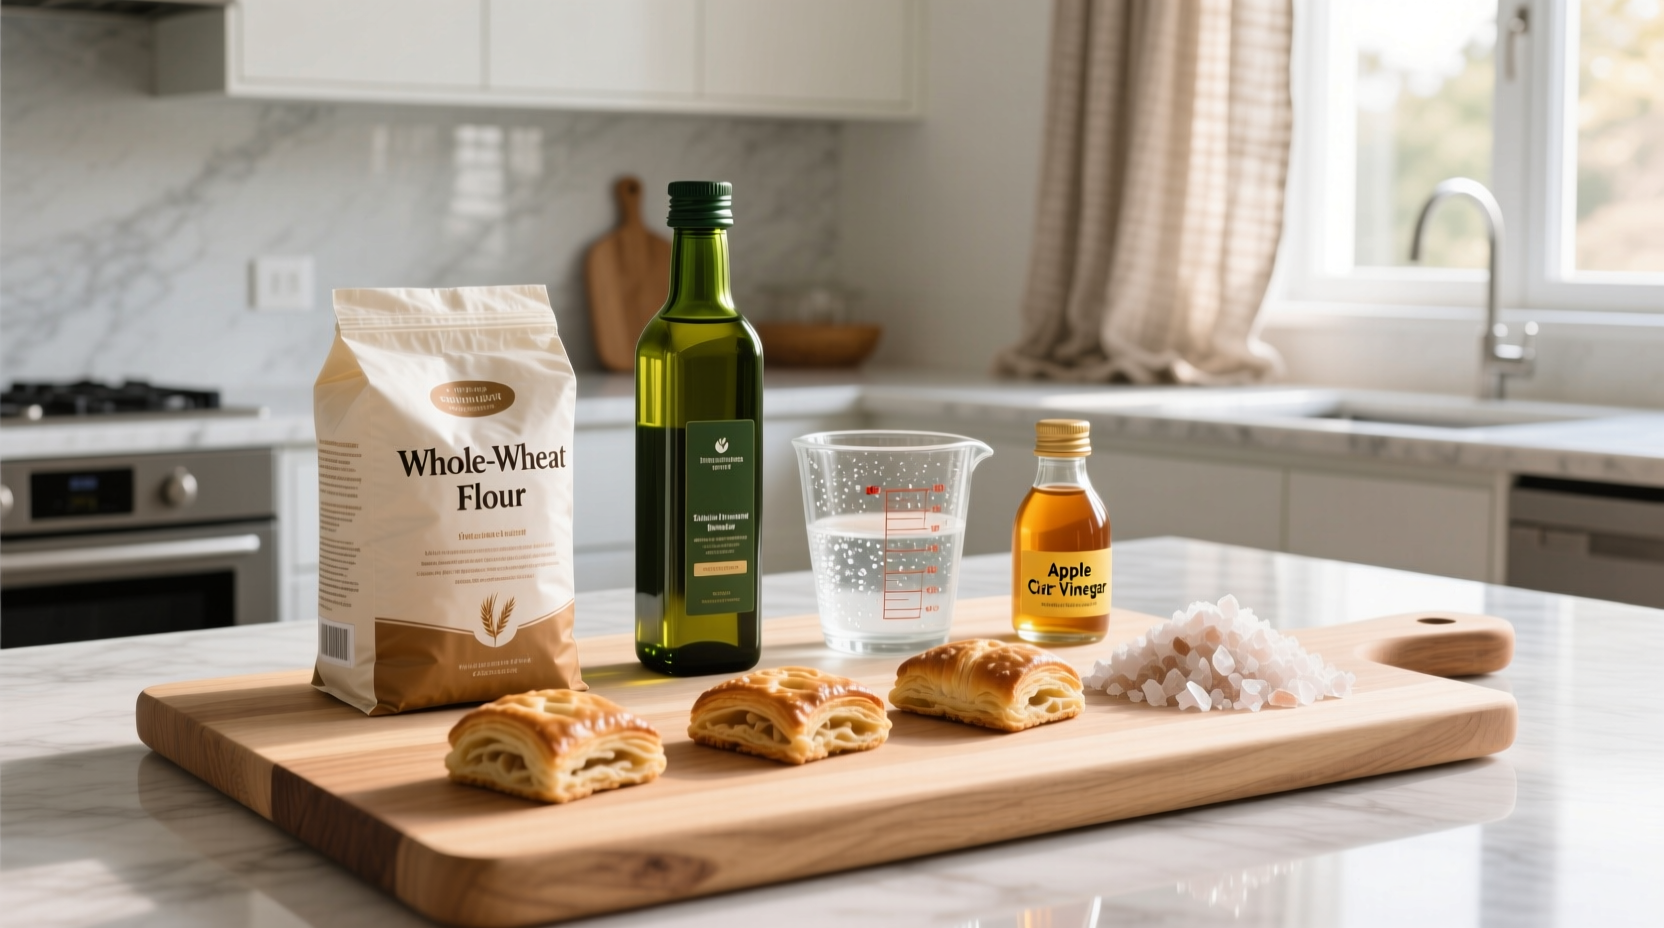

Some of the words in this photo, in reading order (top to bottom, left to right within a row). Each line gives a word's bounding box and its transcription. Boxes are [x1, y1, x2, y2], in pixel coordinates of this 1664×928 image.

[397, 443, 566, 477] Whole-Wheat
[457, 482, 526, 511] Flour
[1048, 562, 1091, 581] Apple
[1059, 582, 1107, 599] Vinegar
